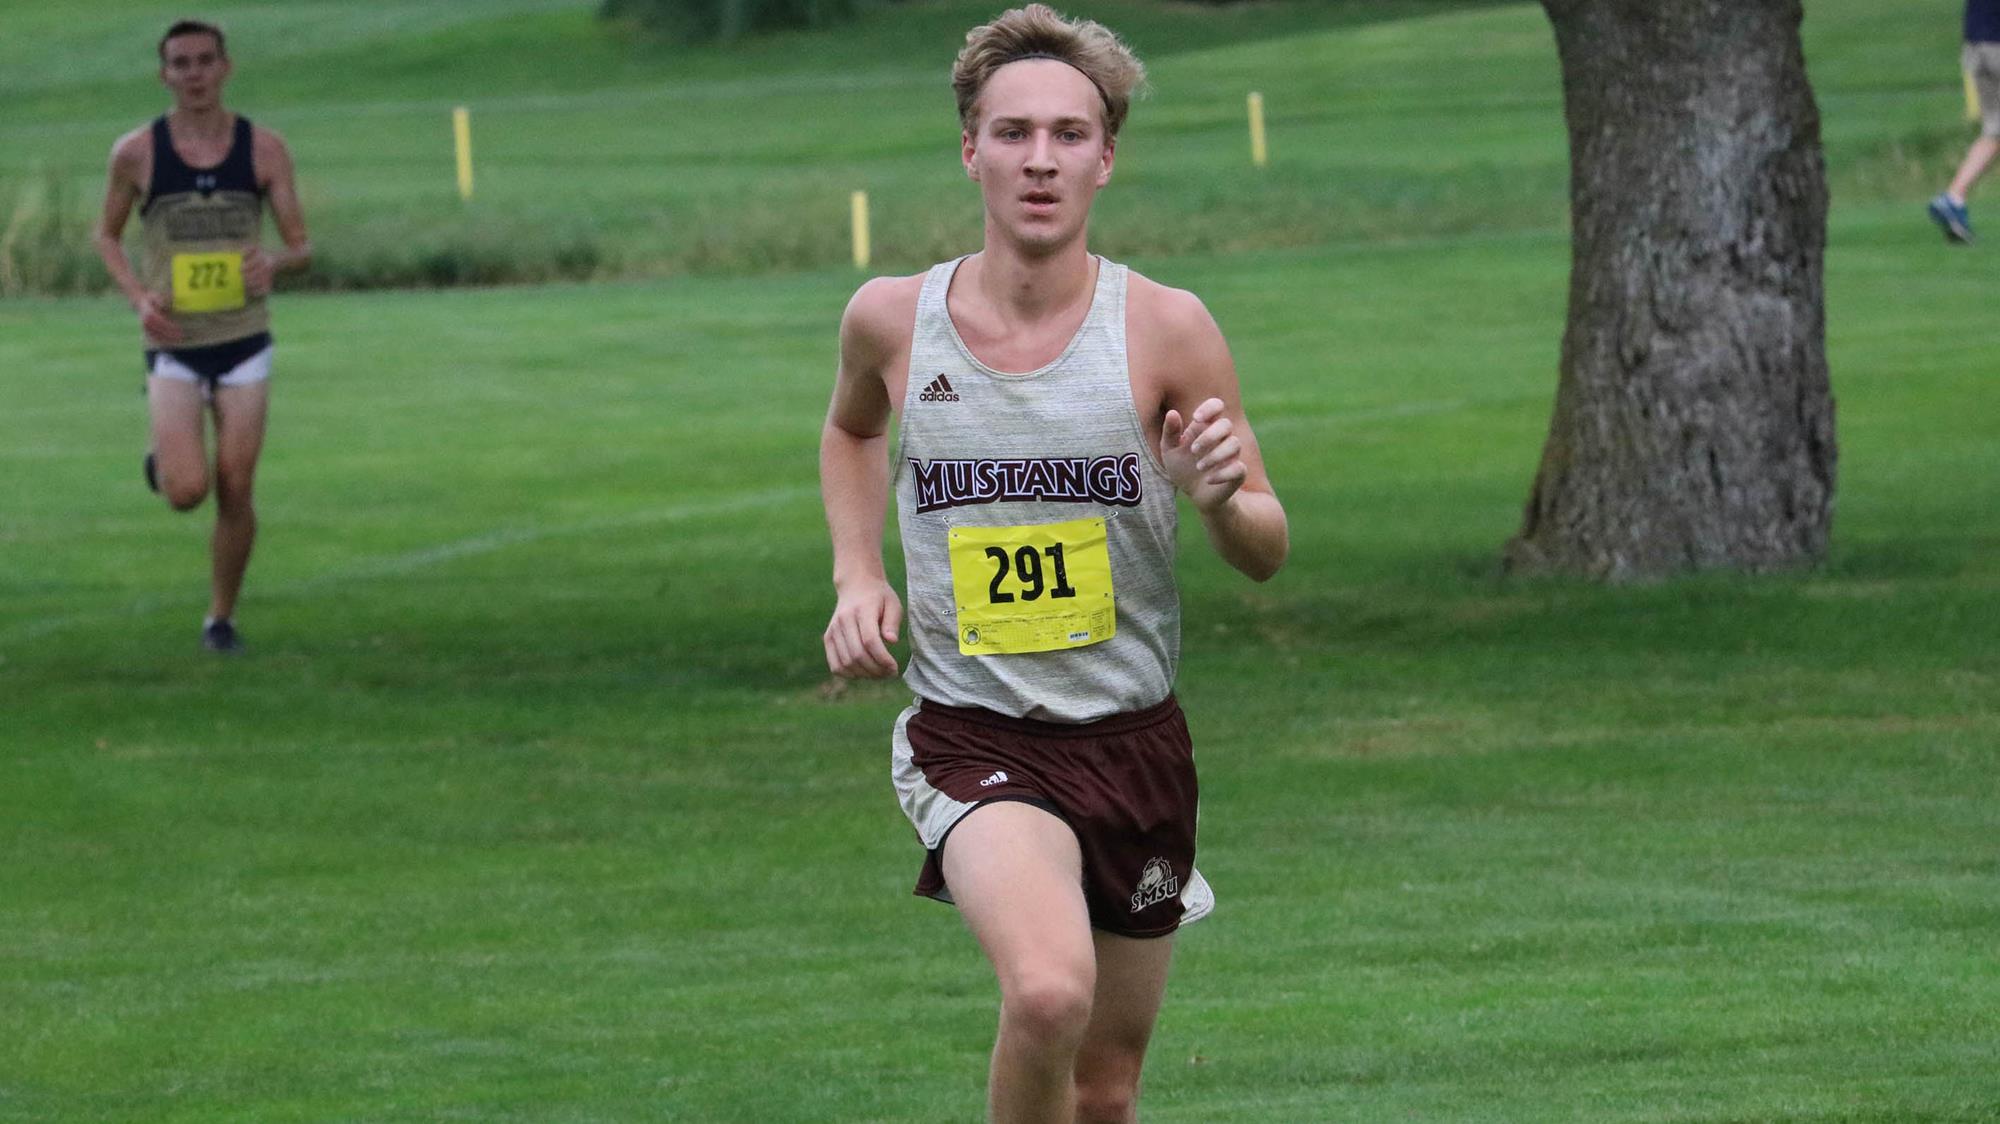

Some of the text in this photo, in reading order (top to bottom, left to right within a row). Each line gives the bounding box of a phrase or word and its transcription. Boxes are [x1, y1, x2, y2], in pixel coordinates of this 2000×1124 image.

[189, 261, 228, 289] 272
[919, 391, 960, 402] adidas
[907, 452, 1142, 514] MUSTANGS
[984, 542, 1076, 604] 291
[1131, 876, 1178, 912] SMSU
